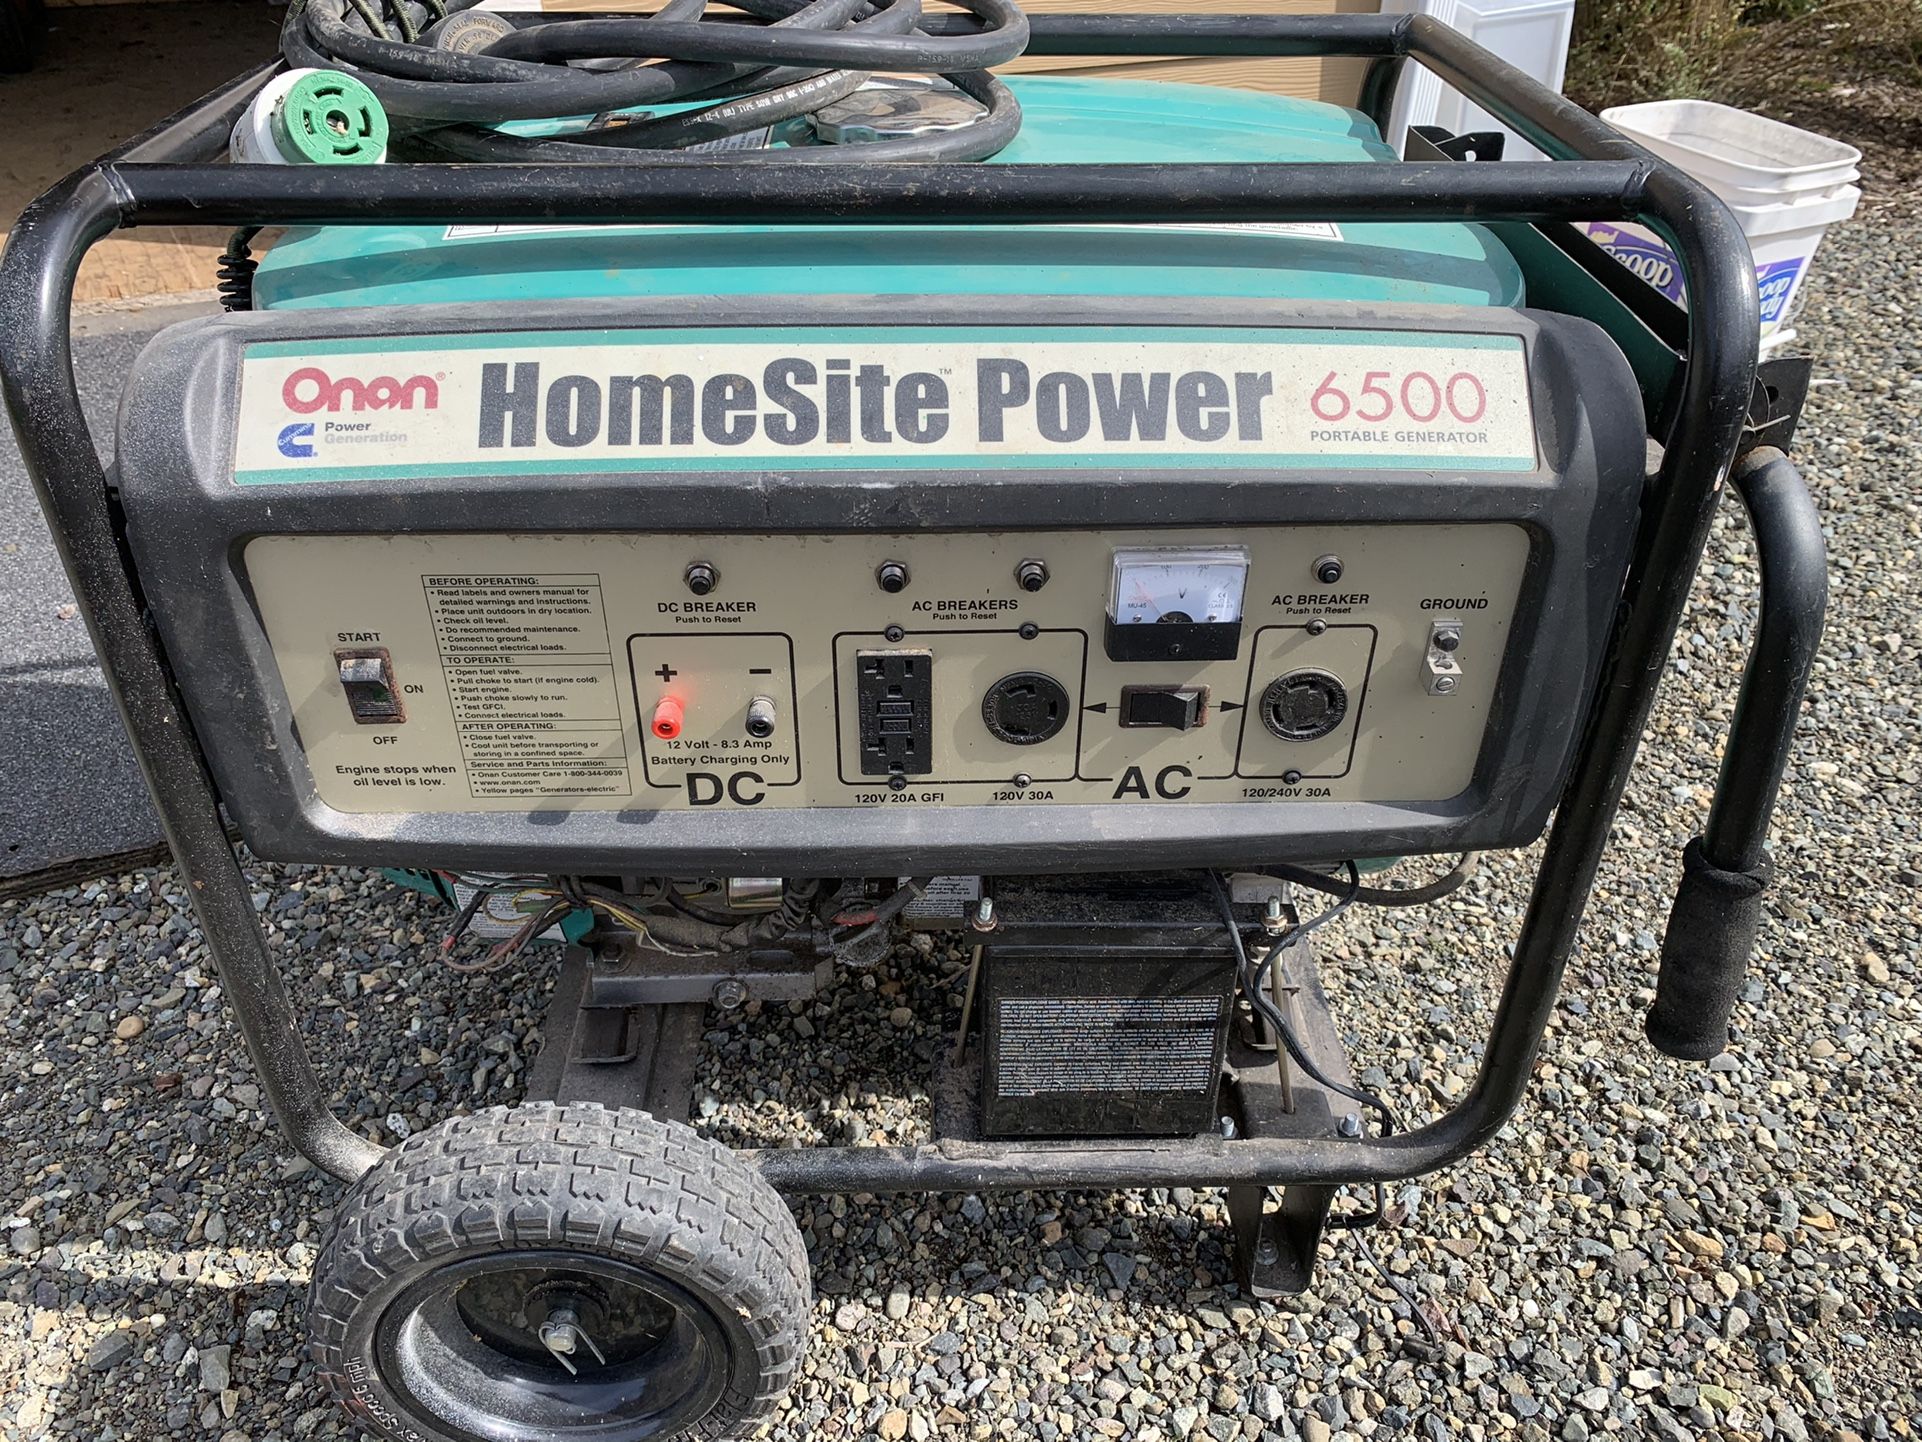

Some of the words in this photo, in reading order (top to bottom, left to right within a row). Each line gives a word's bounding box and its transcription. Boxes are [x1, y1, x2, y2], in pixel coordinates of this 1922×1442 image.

[738, 103, 755, 114] TYPE
[976, 358, 1273, 443] Power
[1310, 370, 1487, 423] 6500
[325, 421, 371, 432] Power
[324, 431, 408, 444] Generation
[1310, 429, 1389, 443] PORTABLE
[1394, 430, 1488, 444] GENERATOR
[475, 577, 539, 585] OPERATING:
[1179, 588, 1187, 599] V
[1272, 595, 1293, 605] AC
[1297, 594, 1369, 604] BREAKER
[1420, 599, 1488, 610] GROUND
[658, 602, 678, 613] DC
[684, 602, 756, 612] BREAKER
[912, 601, 932, 611] AC
[937, 600, 1018, 611] BREAKERS
[538, 608, 552, 616] dry
[338, 633, 380, 642] START
[497, 635, 529, 644] ground.
[479, 668, 495, 676] fuel
[546, 677, 573, 685] engine
[576, 676, 599, 684] cold).
[404, 685, 423, 693] ON
[481, 686, 511, 694] engine.
[512, 694, 538, 702] slowly
[667, 741, 680, 749] 12
[684, 740, 709, 749] Volt
[721, 740, 739, 748] 8.3
[744, 740, 772, 750] Amp
[652, 756, 696, 765] Battery
[701, 756, 757, 765] Charging
[761, 755, 789, 765] Only
[336, 766, 379, 775] Engine
[384, 765, 419, 774] stops
[422, 765, 456, 773] when
[354, 778, 368, 786] oil
[373, 777, 402, 786] level
[420, 777, 445, 785] low.
[1112, 765, 1192, 800] AC
[686, 771, 765, 805] DC
[1242, 788, 1302, 797] 120/240V
[1306, 788, 1330, 796] 30A
[855, 794, 888, 803] 120V
[891, 794, 917, 802] 20A
[921, 793, 944, 801] GFI
[992, 792, 1025, 800] 120V
[1029, 791, 1053, 800] 30A
